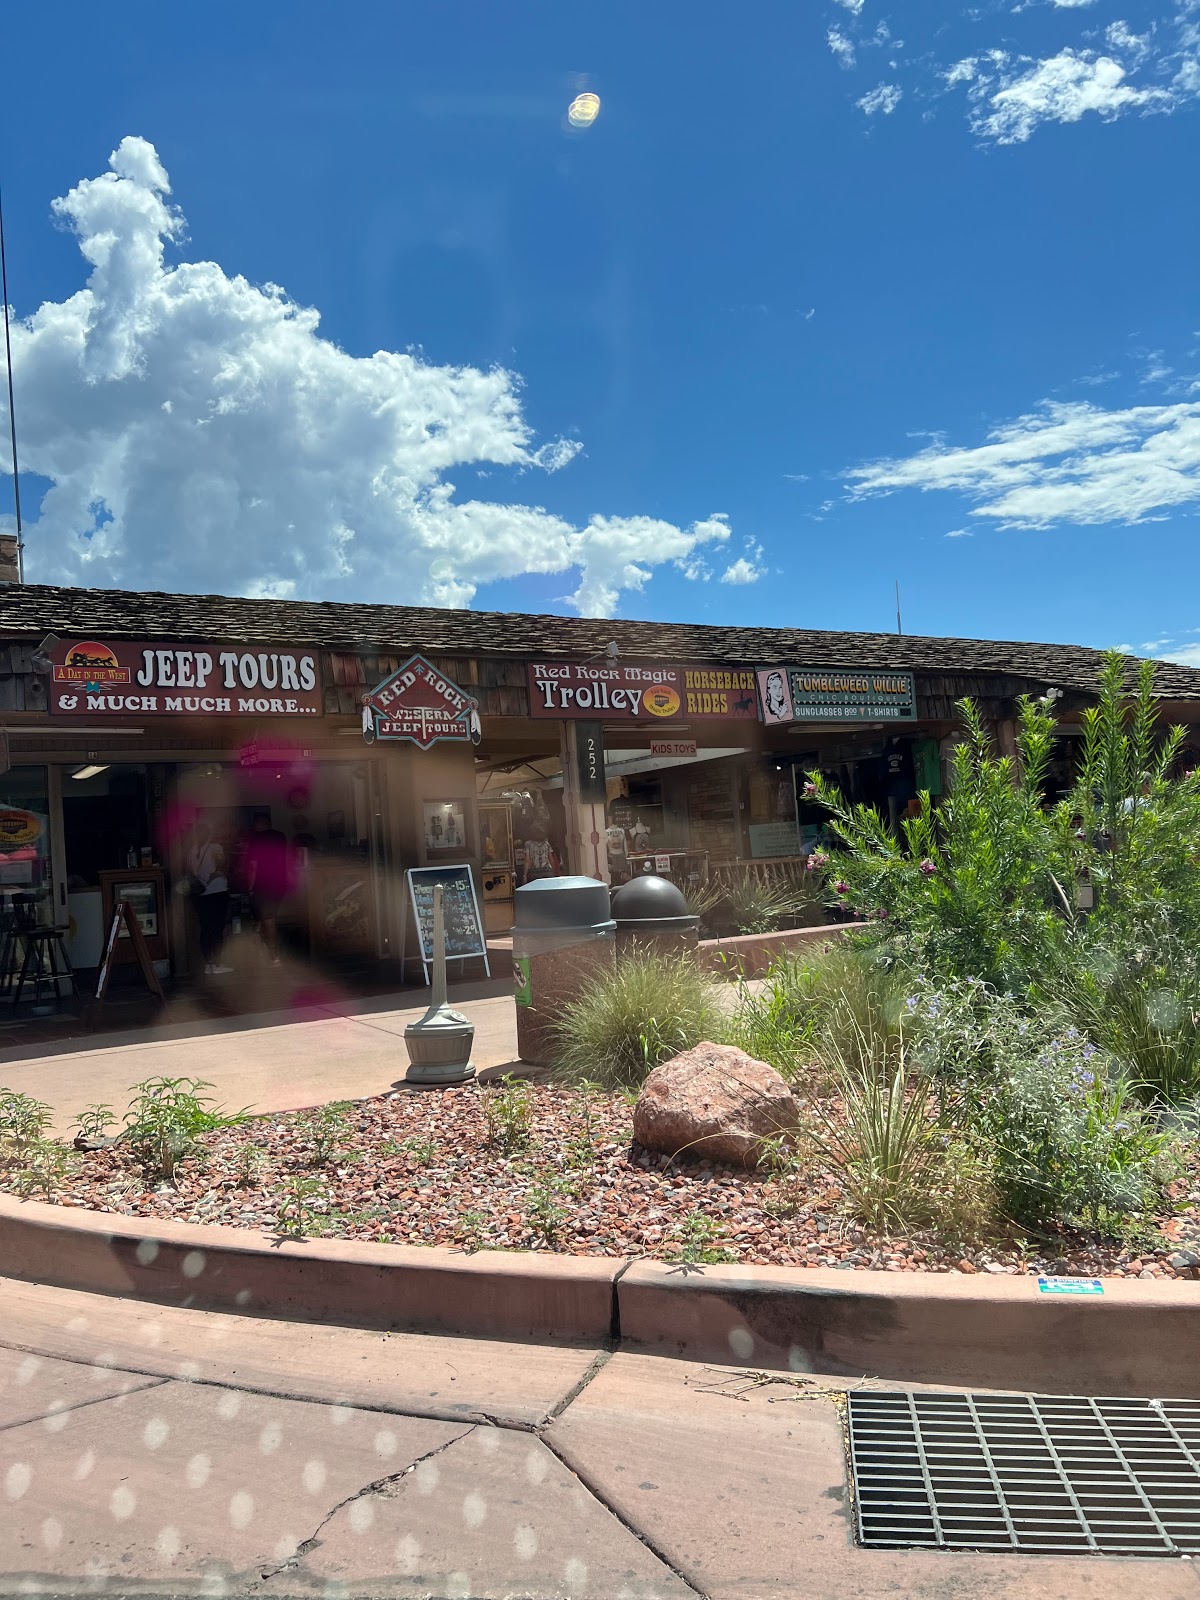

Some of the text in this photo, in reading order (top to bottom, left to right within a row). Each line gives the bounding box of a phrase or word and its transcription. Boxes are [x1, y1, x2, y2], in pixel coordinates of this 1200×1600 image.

[58, 668, 66, 680] A
[83, 671, 92, 680] IN
[93, 671, 106, 680] THE
[108, 669, 127, 681] WEST
[137, 650, 316, 690] JEEP TOURS
[533, 664, 571, 679] Red
[624, 667, 677, 684] Magic
[377, 669, 466, 709] RED ROCK
[685, 671, 755, 690] HORSEBACK
[796, 677, 907, 694] TUMBLEWEED WILLIE
[58, 695, 317, 714] & MUCH MUCH MORE...
[536, 680, 643, 716] Trolley
[687, 693, 728, 714] RIDES
[844, 694, 898, 702] BOUTIQUE
[795, 707, 843, 717] SUNGLASSES
[867, 708, 900, 717] T-SHIRTS
[382, 722, 466, 733] JEEP TOURS
[652, 744, 697, 754] KIDS TOYS
